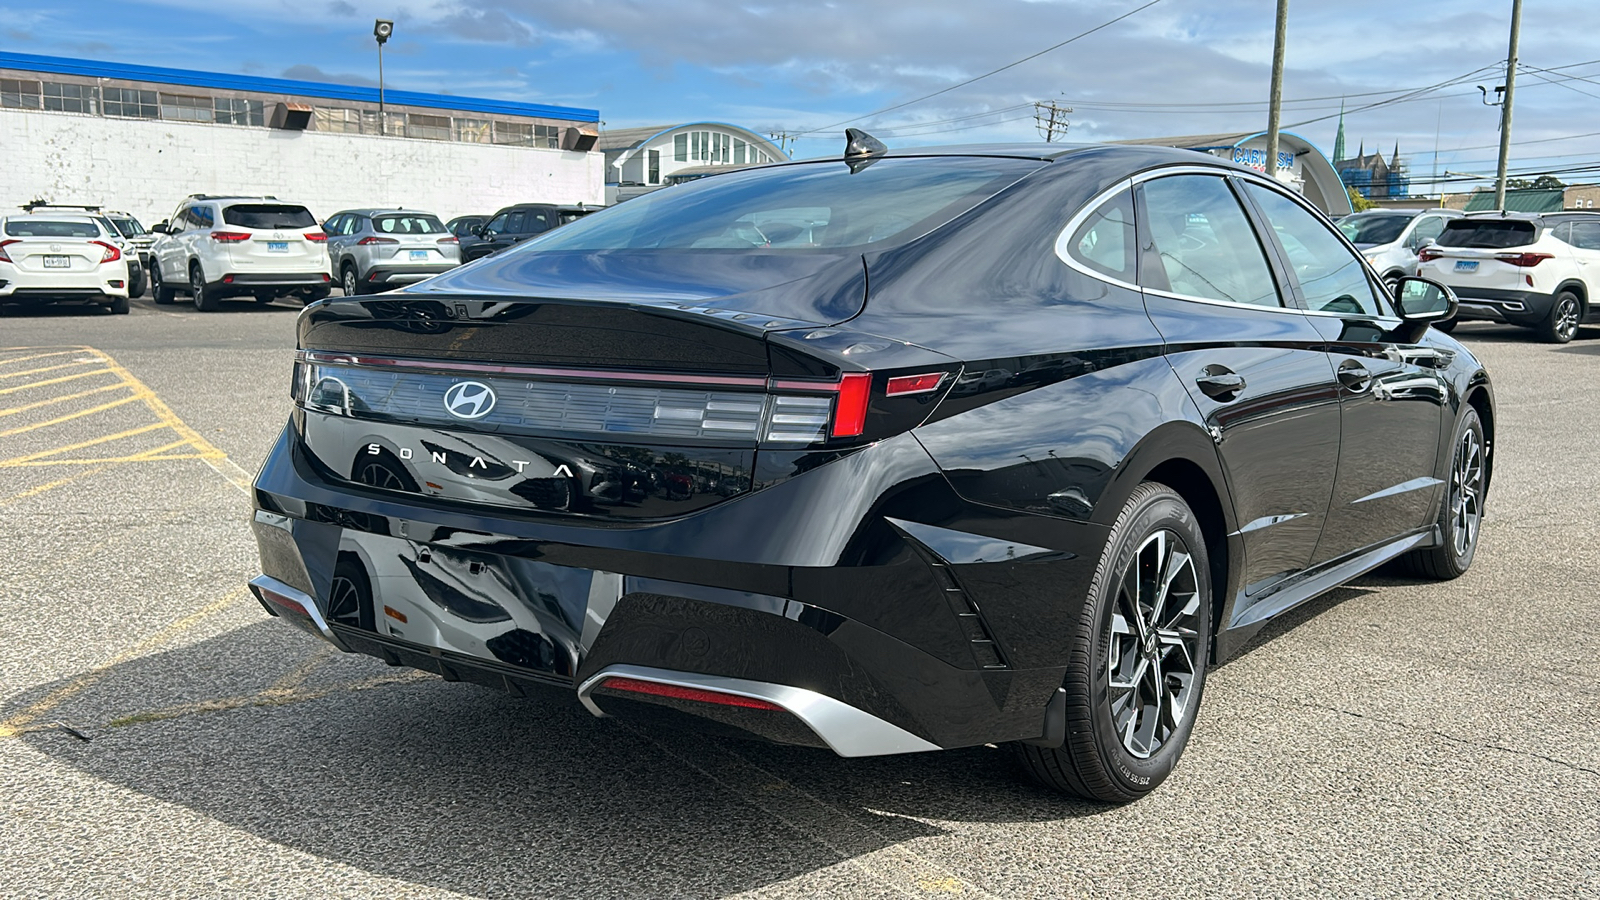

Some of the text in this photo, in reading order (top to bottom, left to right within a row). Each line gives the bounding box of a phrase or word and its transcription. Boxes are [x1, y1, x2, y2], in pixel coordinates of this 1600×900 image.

[1233, 147, 1294, 167] CARWSH
[367, 443, 574, 478] SONATA
[1115, 515, 1150, 577] KUMHO
[1130, 773, 1150, 785] 215/55
